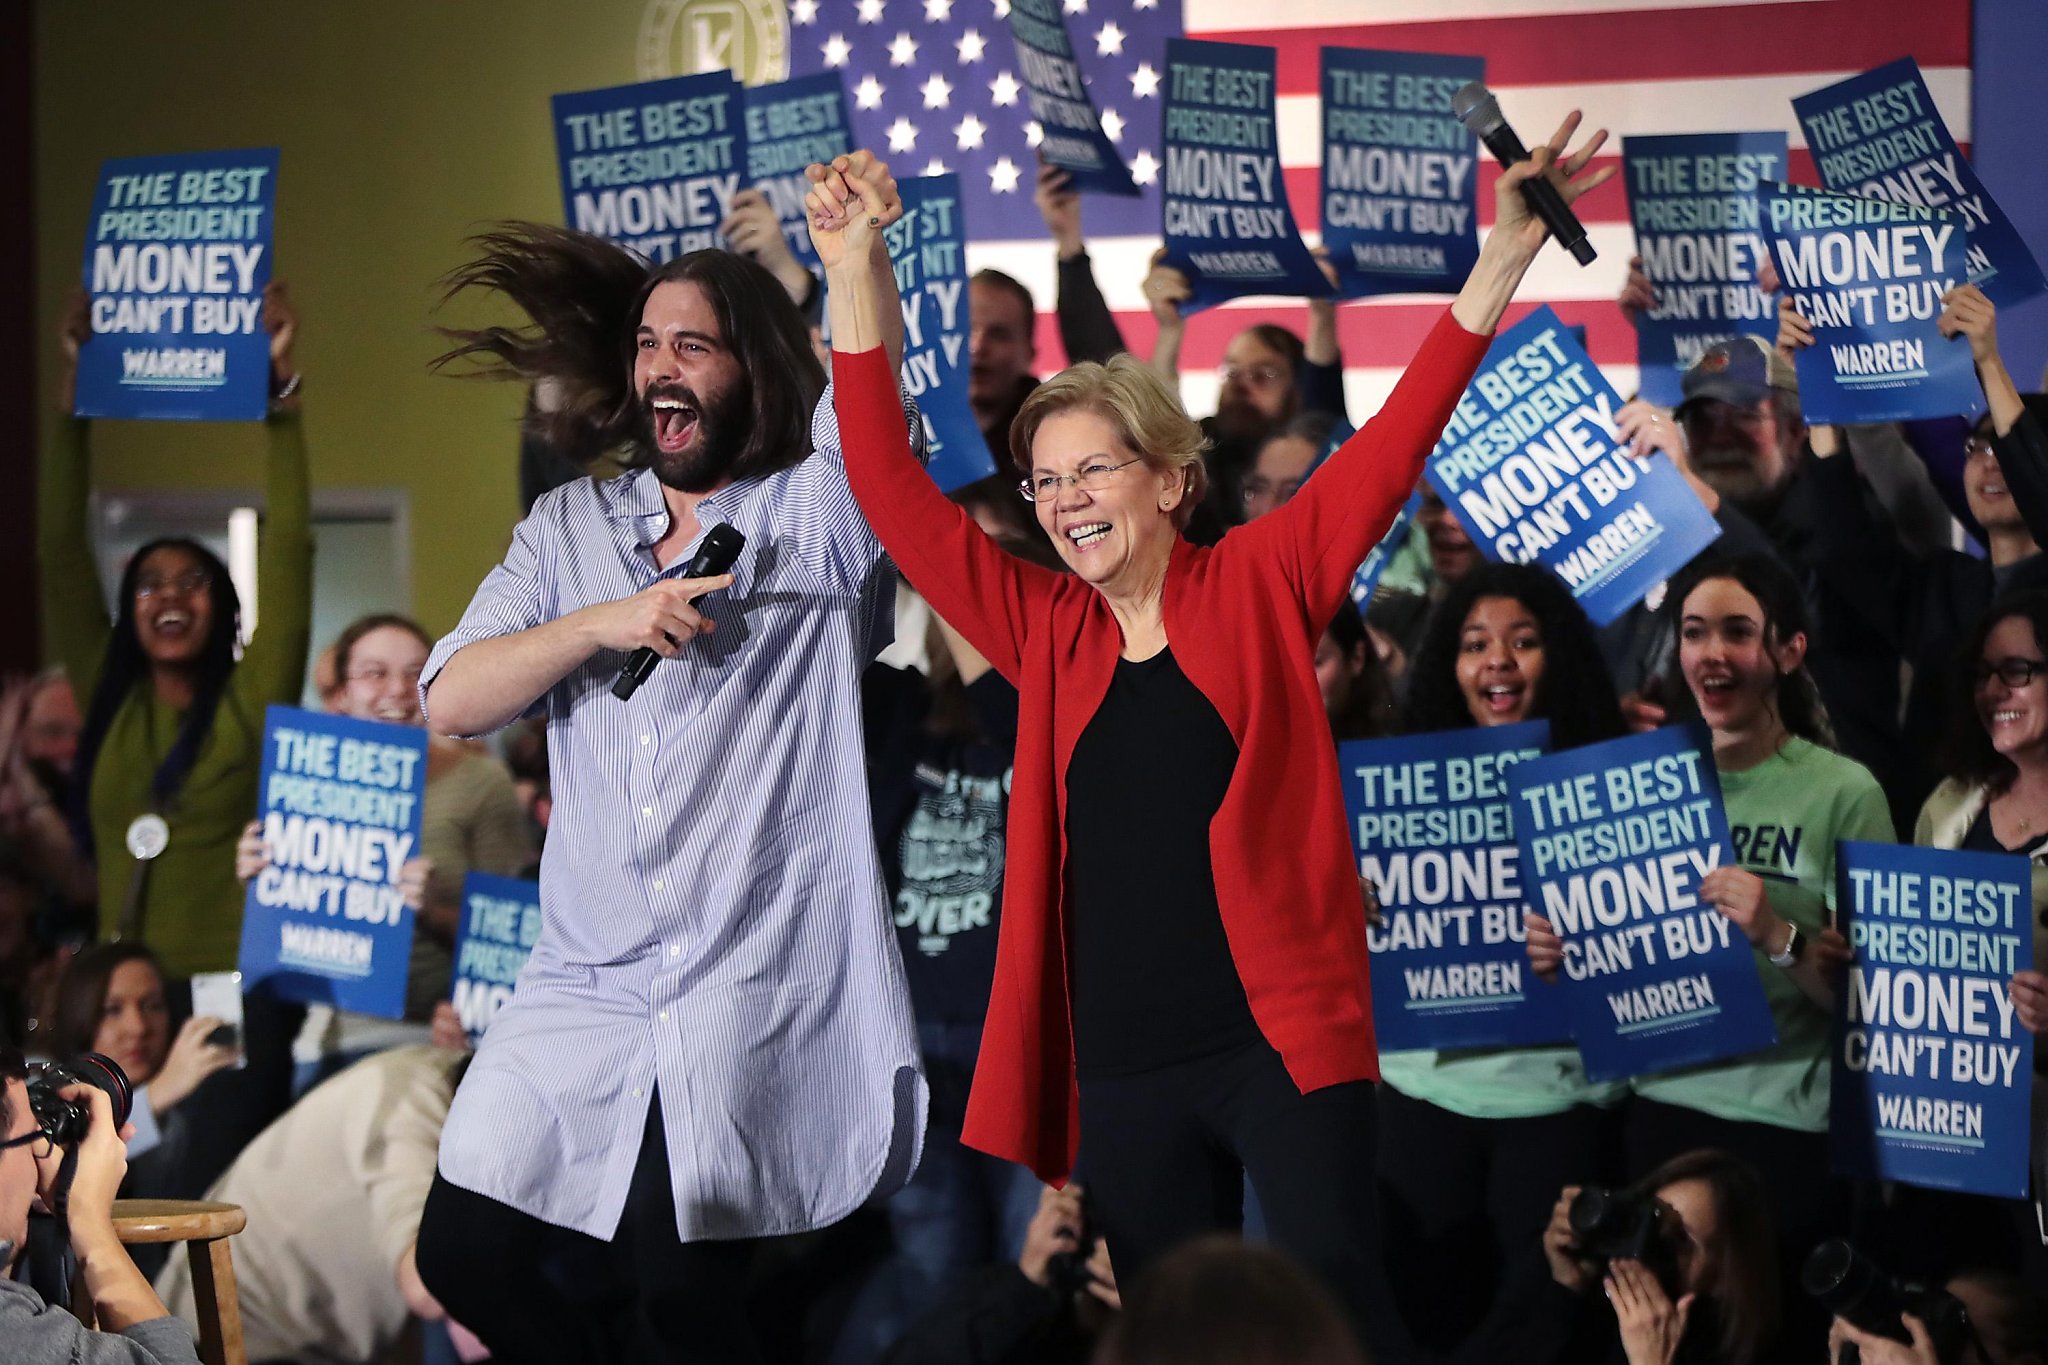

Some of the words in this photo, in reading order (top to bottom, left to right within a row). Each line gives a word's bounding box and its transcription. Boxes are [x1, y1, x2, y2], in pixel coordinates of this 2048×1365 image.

[1170, 63, 1213, 104] THE
[1214, 67, 1271, 109] BEST
[1328, 69, 1390, 108] THE
[564, 107, 640, 152] THE
[640, 93, 730, 143] BEST
[1166, 107, 1271, 149] PRESIDENT
[1328, 109, 1468, 149] PRESIDENT
[1805, 104, 1854, 152] THE
[1850, 79, 1926, 137] BEST
[569, 135, 736, 189] PRESIDENT
[1166, 147, 1275, 202] MONEY
[1328, 146, 1472, 200] MONEY
[1631, 156, 1691, 193] THE
[1695, 153, 1778, 192] BEST
[1820, 120, 1943, 189] PRESIDENT
[1846, 151, 1968, 209] ONEY
[107, 172, 176, 207] THE
[178, 167, 270, 205] BEST
[573, 172, 741, 237] MONEY
[1635, 196, 1760, 231] PRESIDEN
[96, 206, 264, 241] PRESIDENT
[1165, 200, 1229, 239] CAN'T
[1231, 207, 1287, 239] BUY
[1326, 193, 1407, 232] CAN'T
[1410, 201, 1470, 236] BUY
[92, 243, 264, 294] MONEY
[1189, 251, 1282, 273] WARREN
[1352, 242, 1446, 269] WARREN
[1775, 224, 1956, 289] MONEY
[91, 297, 191, 335] CAN'T
[193, 297, 261, 335] BUY
[1722, 285, 1775, 320] BUY
[1794, 286, 1879, 329] CAN'T
[1885, 278, 1956, 325] BUY
[122, 348, 226, 379] WARREN
[1474, 327, 1568, 412] BEST
[1830, 338, 1925, 376] WARREN
[1435, 362, 1593, 493] PRESIDENT
[1458, 392, 1622, 540] MONEY
[1495, 481, 1591, 565] CAN'T
[1554, 501, 1657, 589] WARREN
[273, 727, 337, 778] THE
[339, 738, 420, 791] BEST
[1355, 761, 1438, 808] THE
[268, 771, 416, 831] PRESIDENT
[1521, 773, 1602, 832] THE
[1604, 750, 1702, 814] BEST
[263, 810, 413, 885] MONEY
[1358, 802, 1514, 850] PRESIDE
[1532, 800, 1712, 878] PRESIDENT
[1731, 825, 1802, 870] REN
[255, 867, 345, 917] CAN'T
[345, 879, 406, 927] BUY
[1360, 847, 1522, 907] MONE
[1541, 842, 1722, 938] MONEY
[1848, 868, 1921, 921] THE
[1929, 873, 2021, 930] BEST
[281, 922, 373, 963] WARREN
[468, 894, 518, 939] THE
[1366, 908, 1475, 954] CAN'T
[1482, 903, 1532, 946] BU
[1561, 922, 1656, 983] CAN'T
[1662, 909, 1732, 961] BUY
[1852, 920, 2021, 976] PRESIDENT
[1404, 961, 1522, 1001] WARREN
[1606, 972, 1715, 1026] WARREN
[1848, 966, 2017, 1040] MONEY
[1844, 1029, 1947, 1080] CAN'T
[1951, 1039, 2021, 1089] BUY
[1876, 1092, 1983, 1139] WARREN
